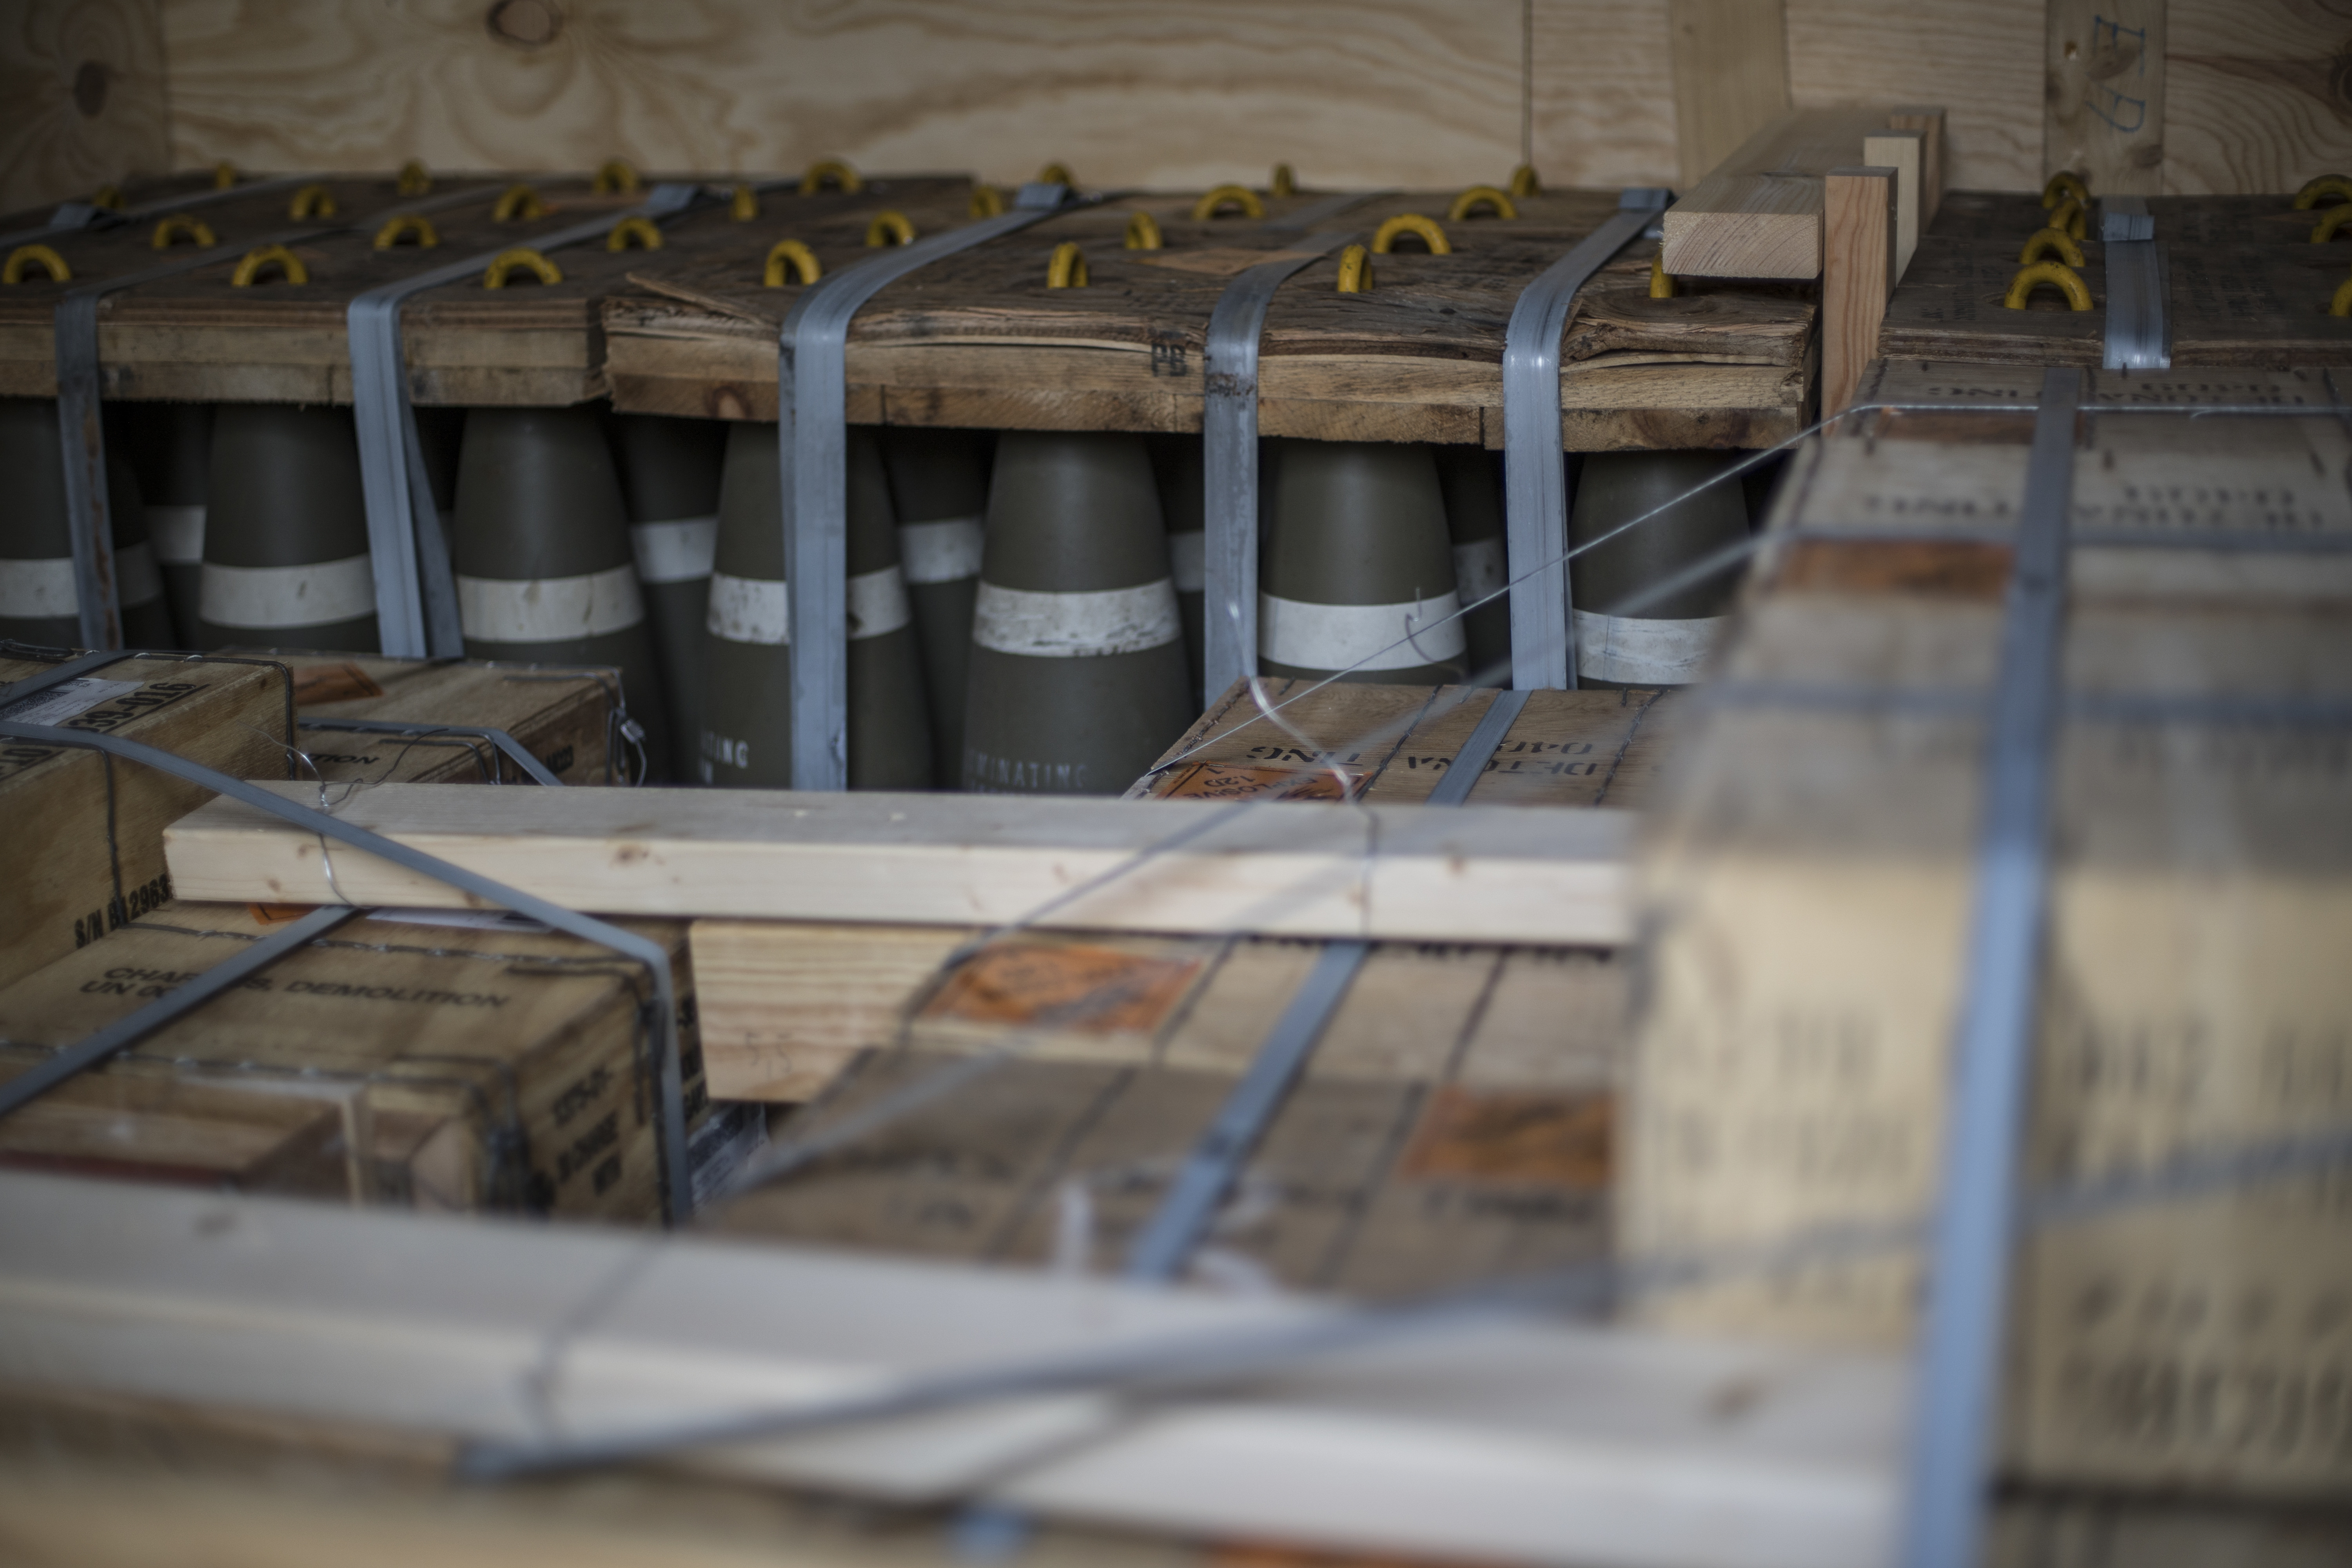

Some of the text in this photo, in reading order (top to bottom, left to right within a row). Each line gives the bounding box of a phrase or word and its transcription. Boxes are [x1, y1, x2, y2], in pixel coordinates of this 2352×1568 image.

[1203, 775, 1256, 787] 1.2D
[80, 981, 136, 995] UN
[285, 981, 510, 1008] DEMOLITION
